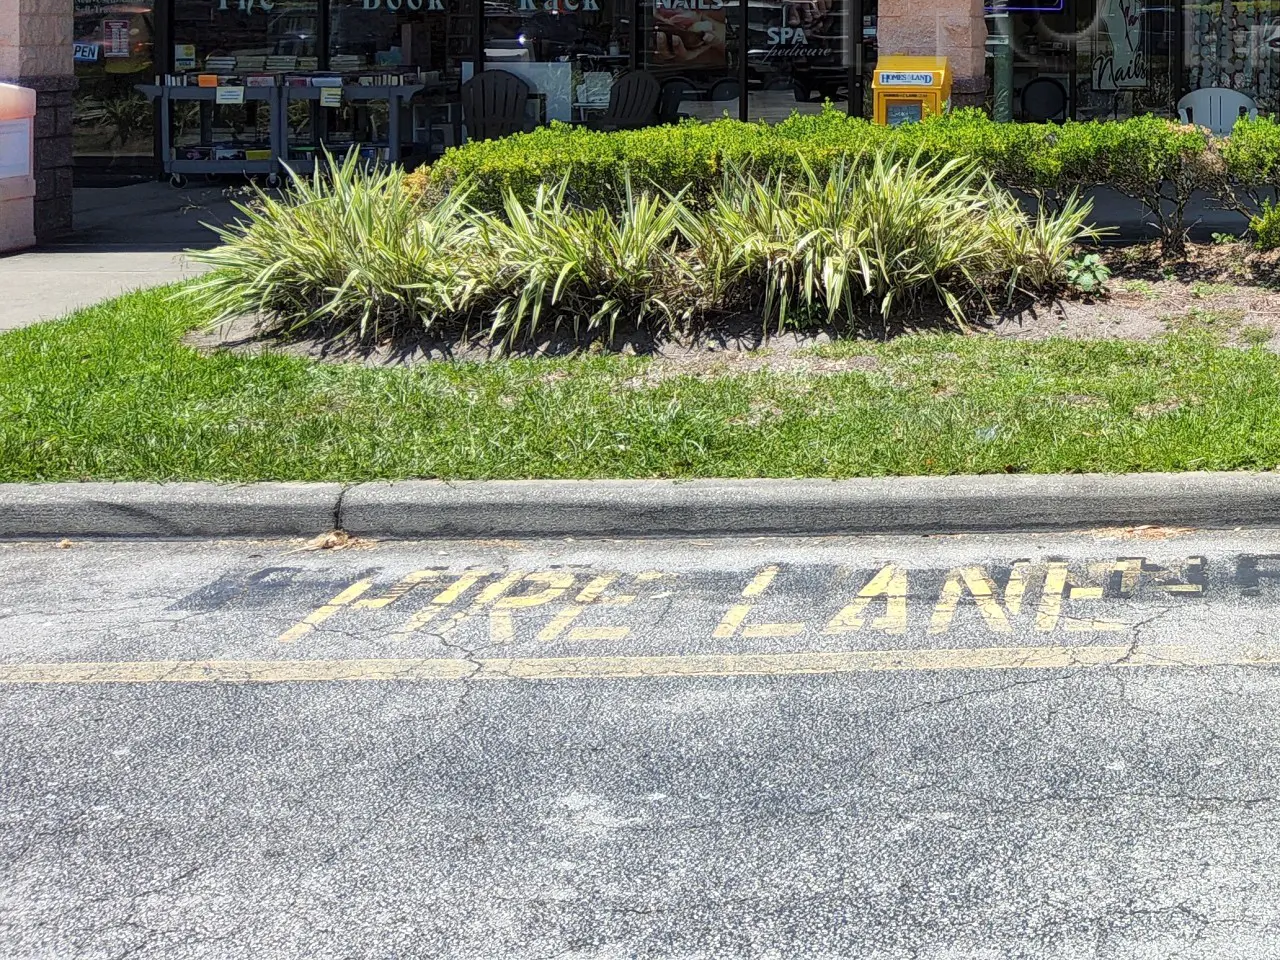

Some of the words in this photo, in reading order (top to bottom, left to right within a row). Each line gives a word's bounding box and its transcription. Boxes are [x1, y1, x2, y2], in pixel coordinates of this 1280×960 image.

[767, 27, 808, 45] SPA
[73, 45, 96, 58] PEN
[762, 43, 832, 63] pedicure
[881, 73, 906, 83] HOMES
[911, 73, 932, 83] LAND
[1092, 52, 1148, 89] Nails
[278, 567, 680, 642] FIRE
[704, 558, 1150, 640] LANE
